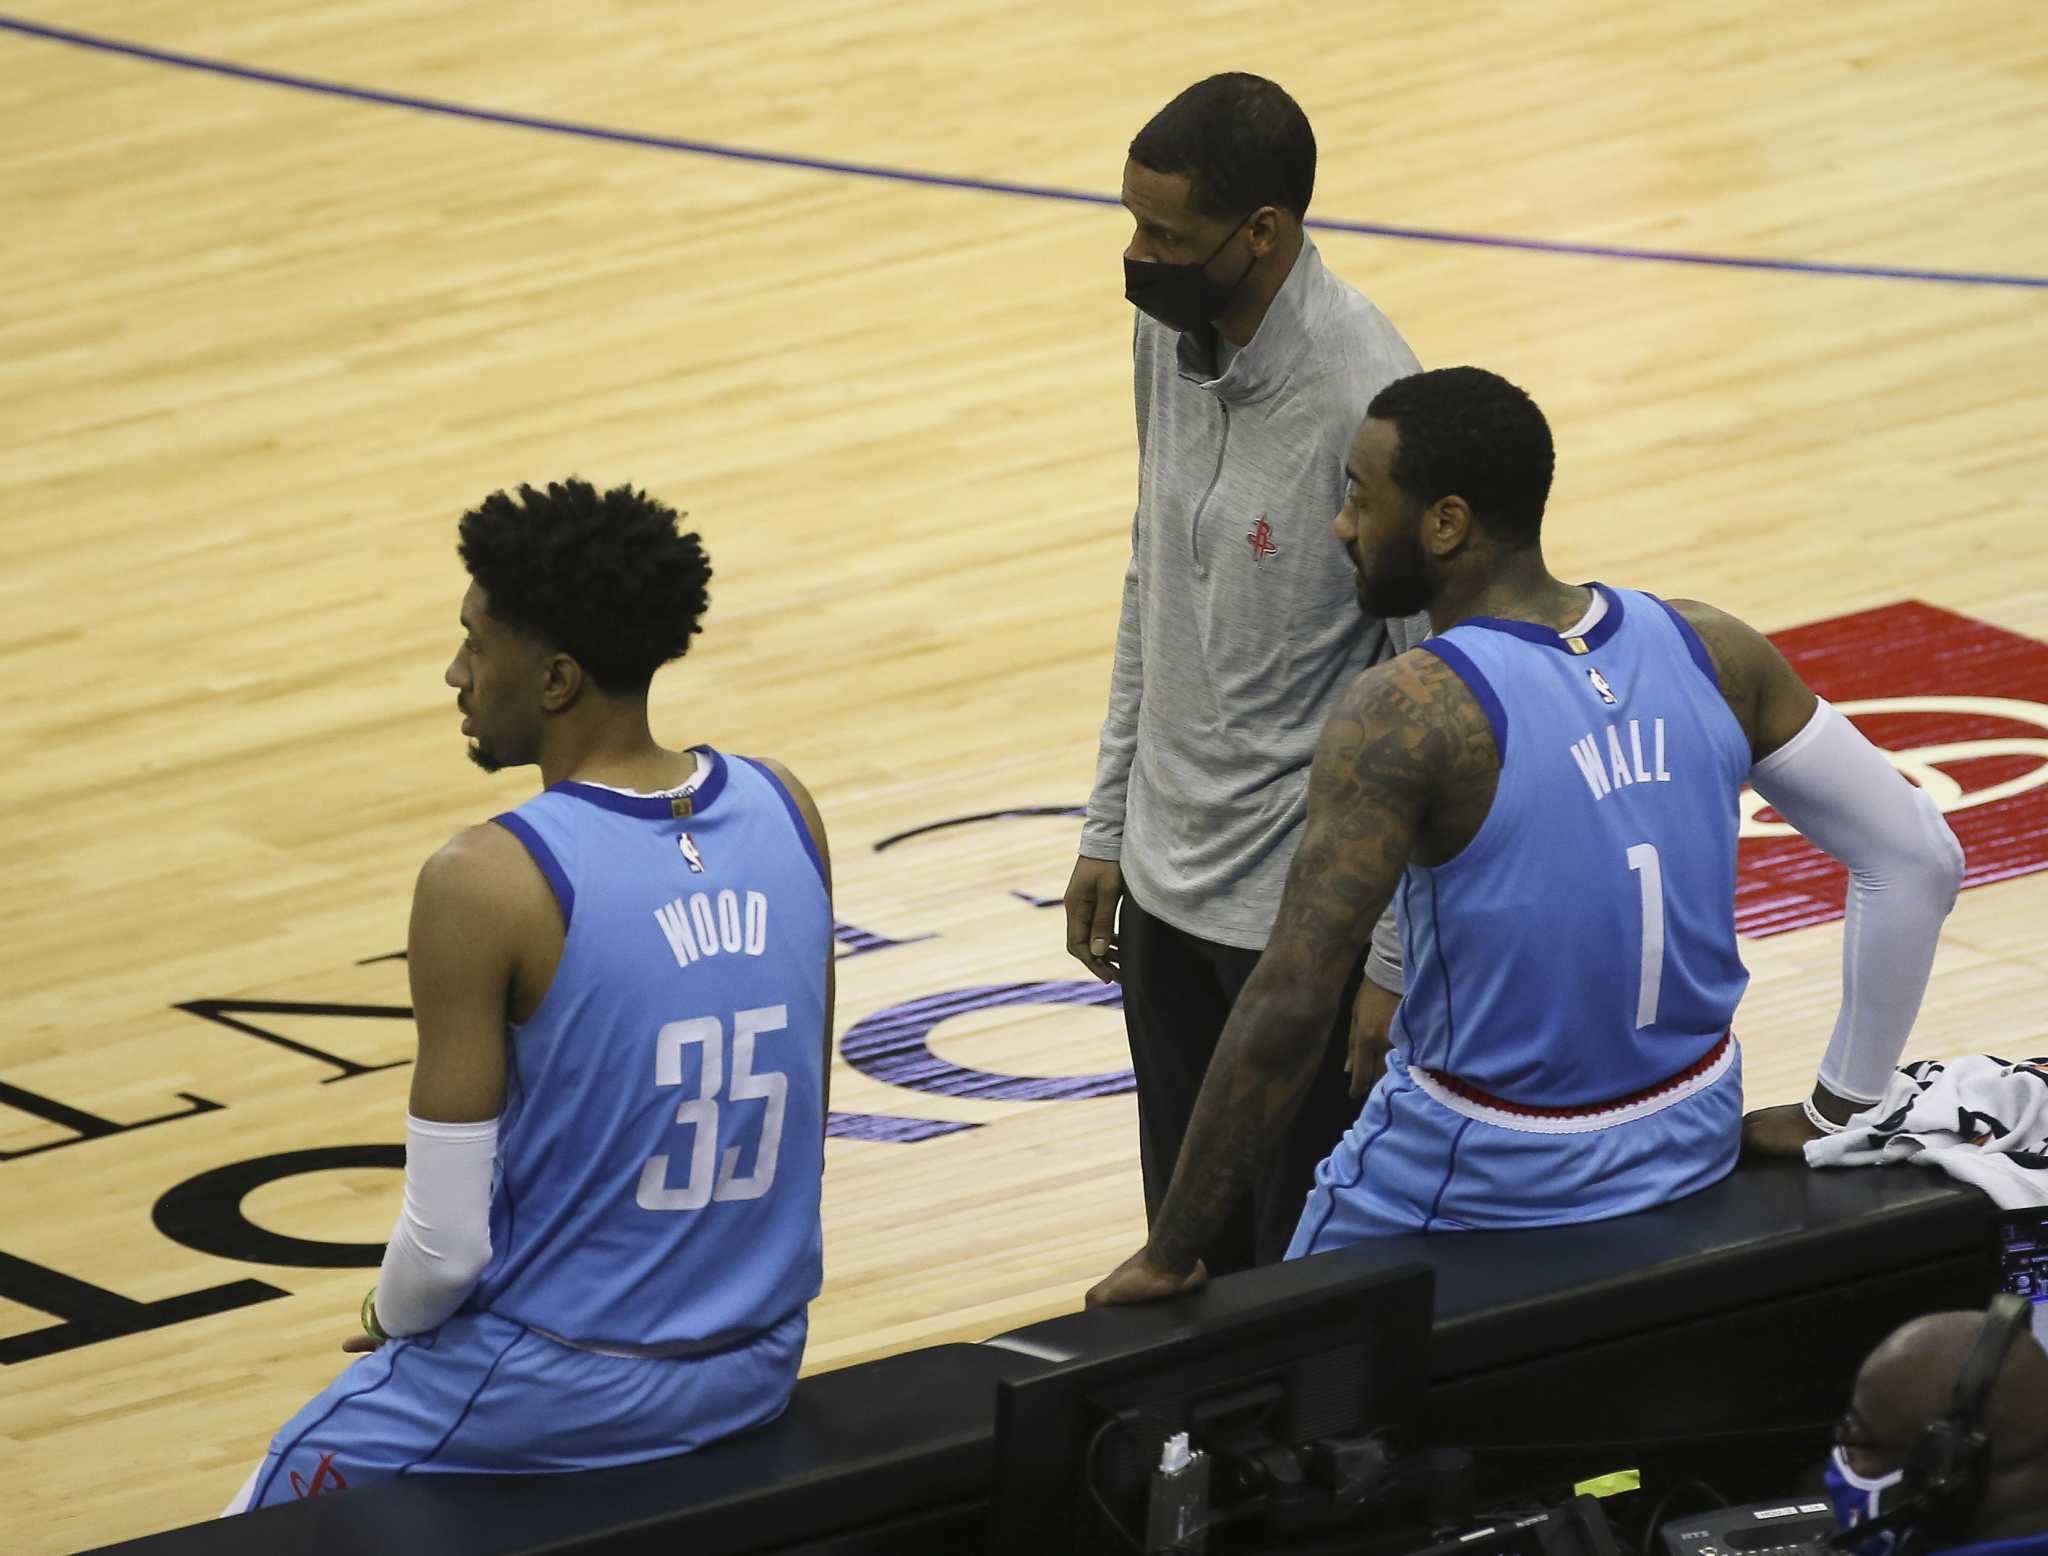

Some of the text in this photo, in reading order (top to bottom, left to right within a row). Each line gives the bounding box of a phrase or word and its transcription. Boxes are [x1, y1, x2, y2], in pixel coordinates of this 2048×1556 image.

[1569, 717, 1671, 801] WALL
[653, 889, 768, 968] WOOD
[1626, 842, 1665, 1030] 1
[636, 1003, 789, 1211] 35
